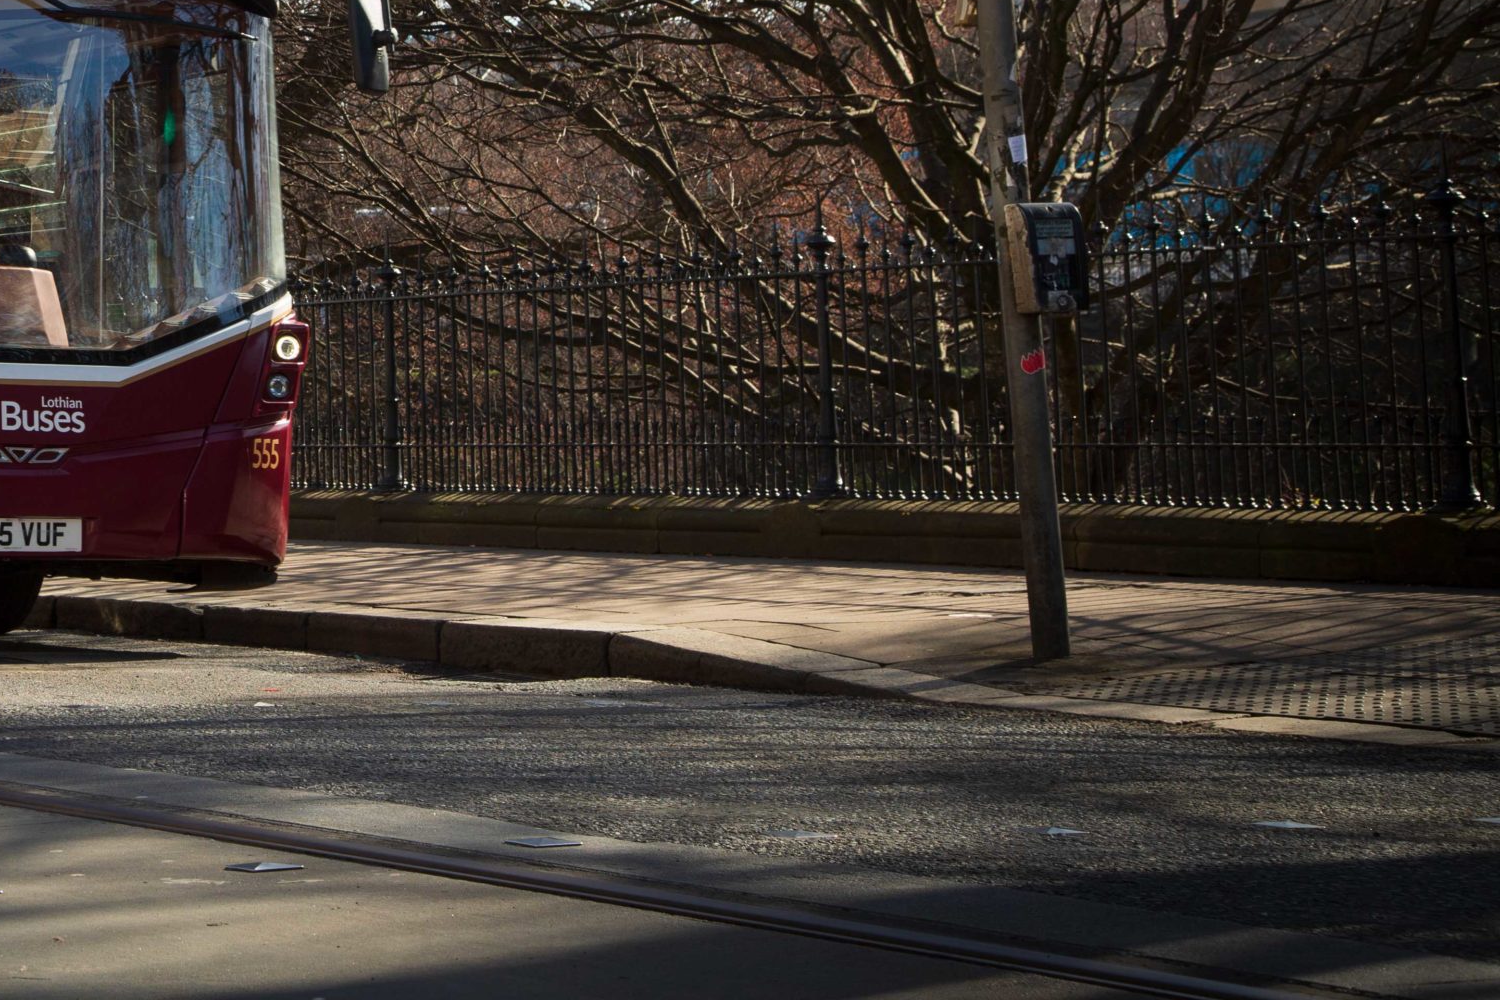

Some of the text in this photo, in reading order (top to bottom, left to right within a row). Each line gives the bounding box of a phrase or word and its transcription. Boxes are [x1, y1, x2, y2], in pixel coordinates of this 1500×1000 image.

[41, 395, 83, 409] Lothian
[0, 400, 86, 433] Buses
[252, 438, 280, 470] 555
[21, 522, 67, 547] VUF
